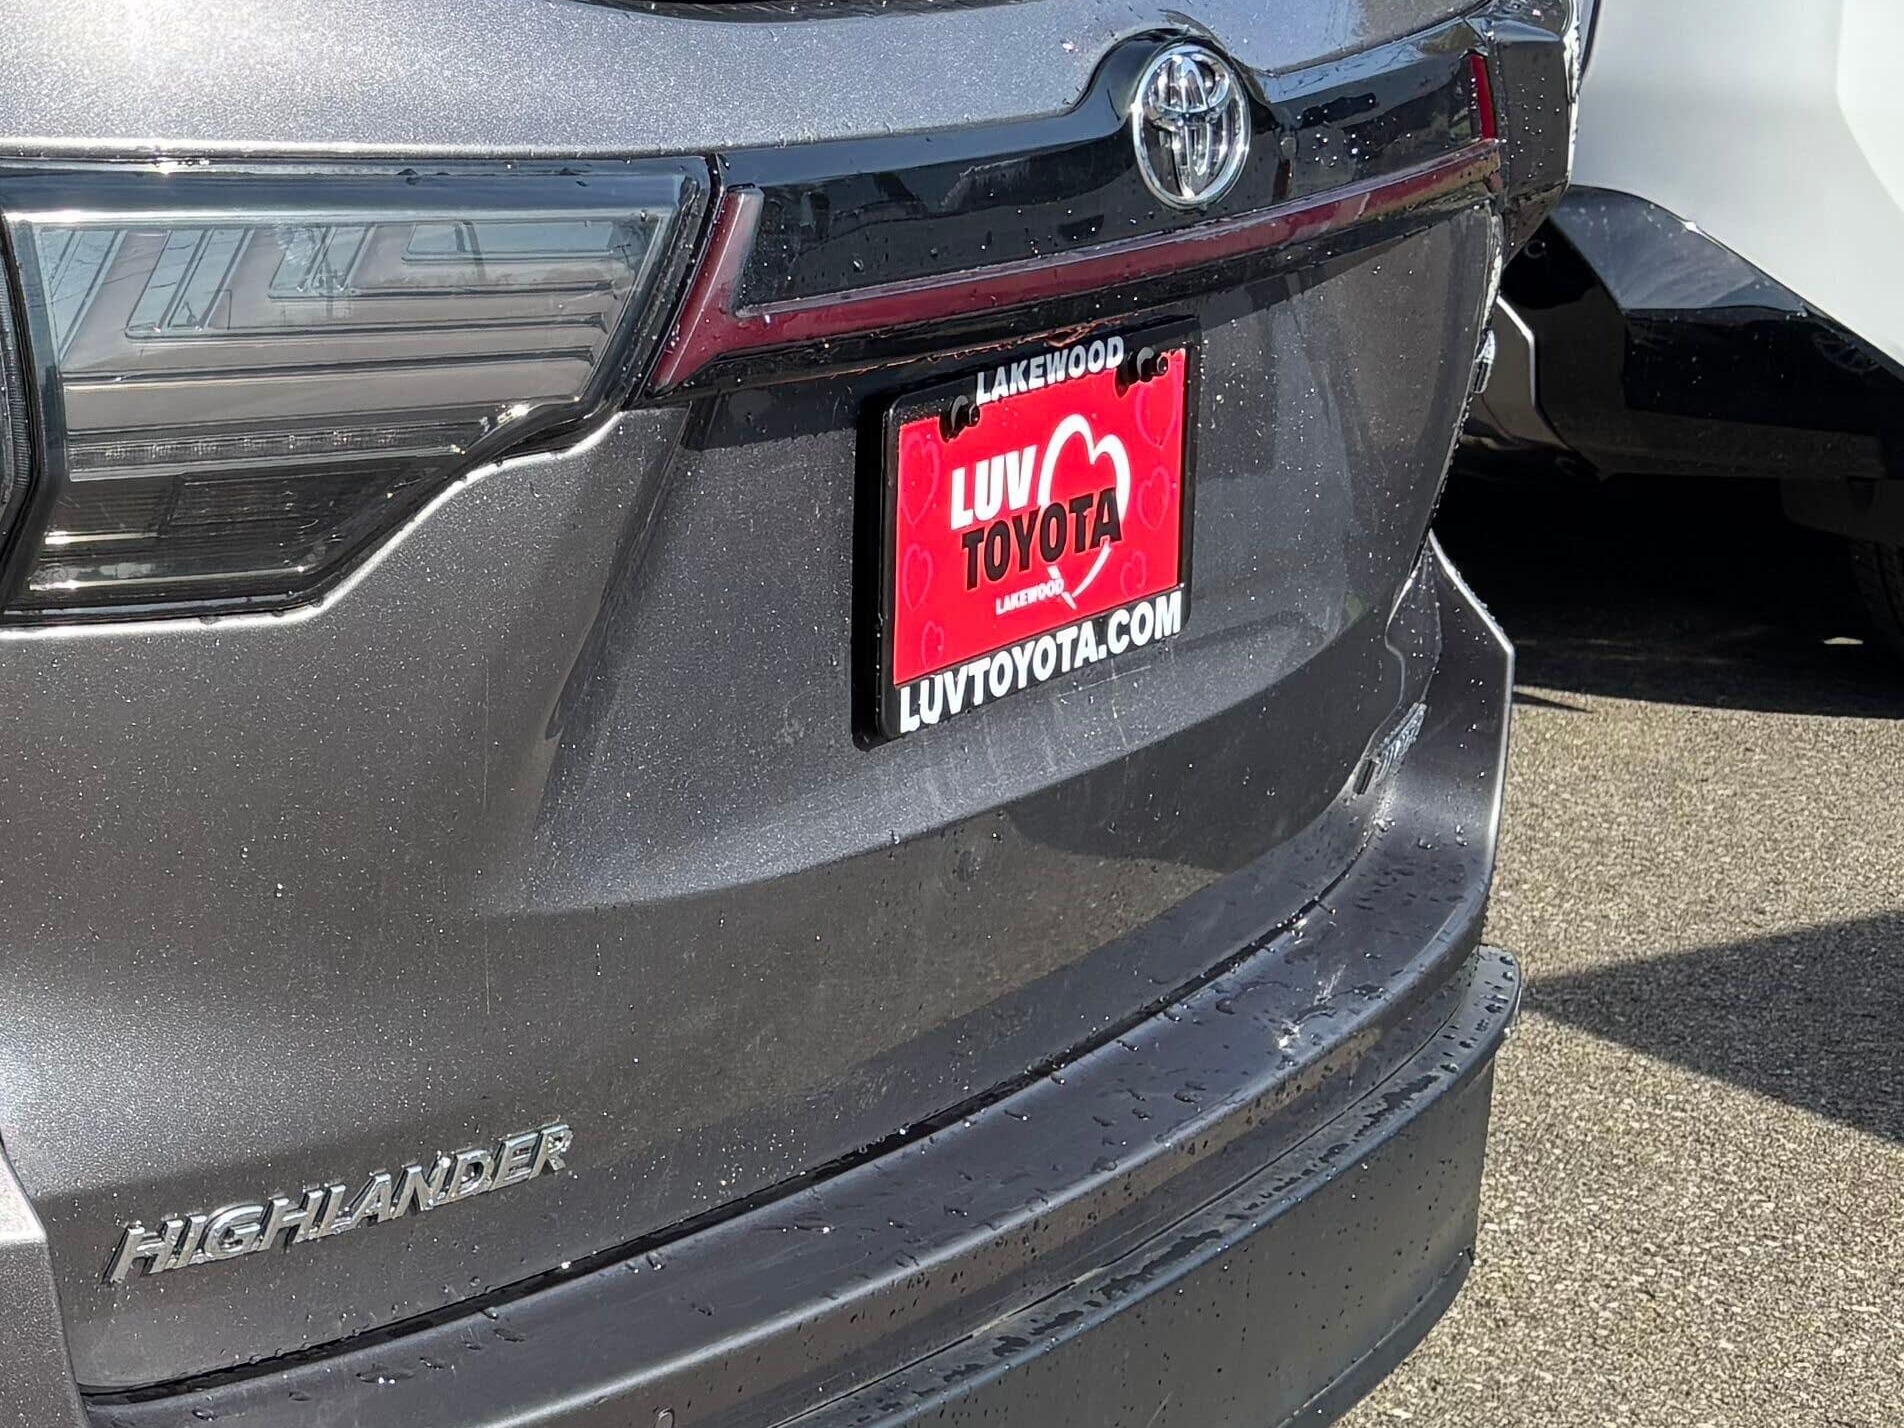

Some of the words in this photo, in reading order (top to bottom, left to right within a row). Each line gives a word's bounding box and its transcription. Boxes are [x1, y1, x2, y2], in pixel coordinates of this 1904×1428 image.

[975, 335, 1125, 407] LAKEWOOD
[949, 445, 1041, 532] LUV
[962, 487, 1123, 591] TOYOTA
[995, 577, 1065, 616] LAKEWOOD
[899, 589, 1183, 734] LUVTOYOTA.COM
[102, 1122, 574, 1285] HIGHLANDER
